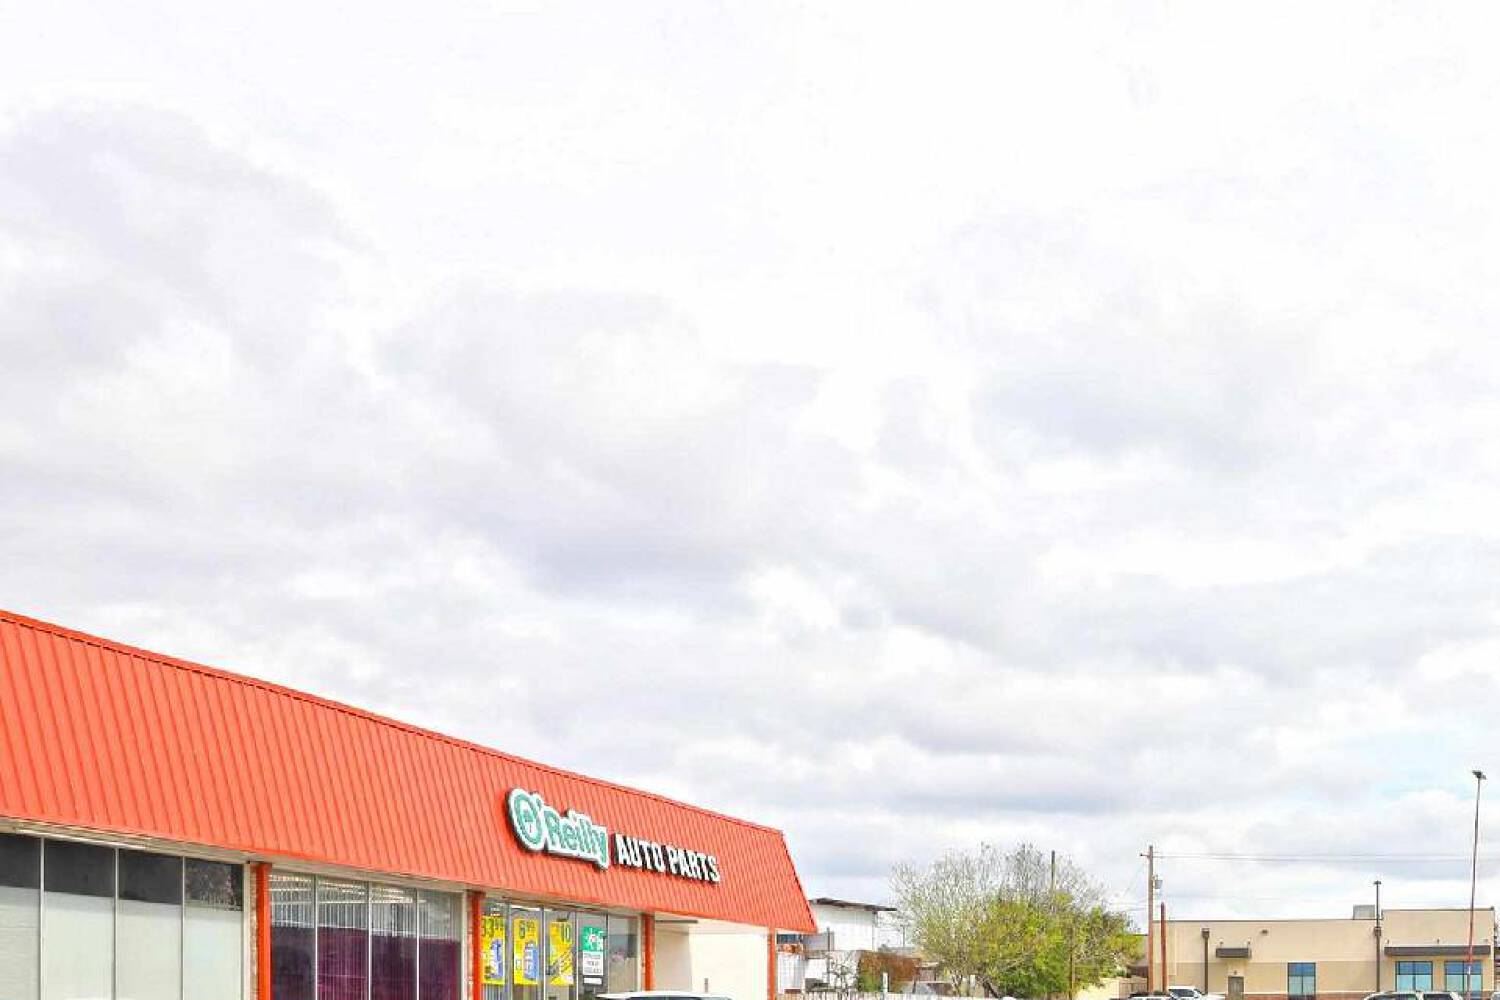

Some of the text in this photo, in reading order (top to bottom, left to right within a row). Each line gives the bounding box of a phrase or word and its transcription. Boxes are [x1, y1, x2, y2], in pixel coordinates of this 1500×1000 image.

[511, 789, 720, 882] O'Reilly AUTO PARTS
